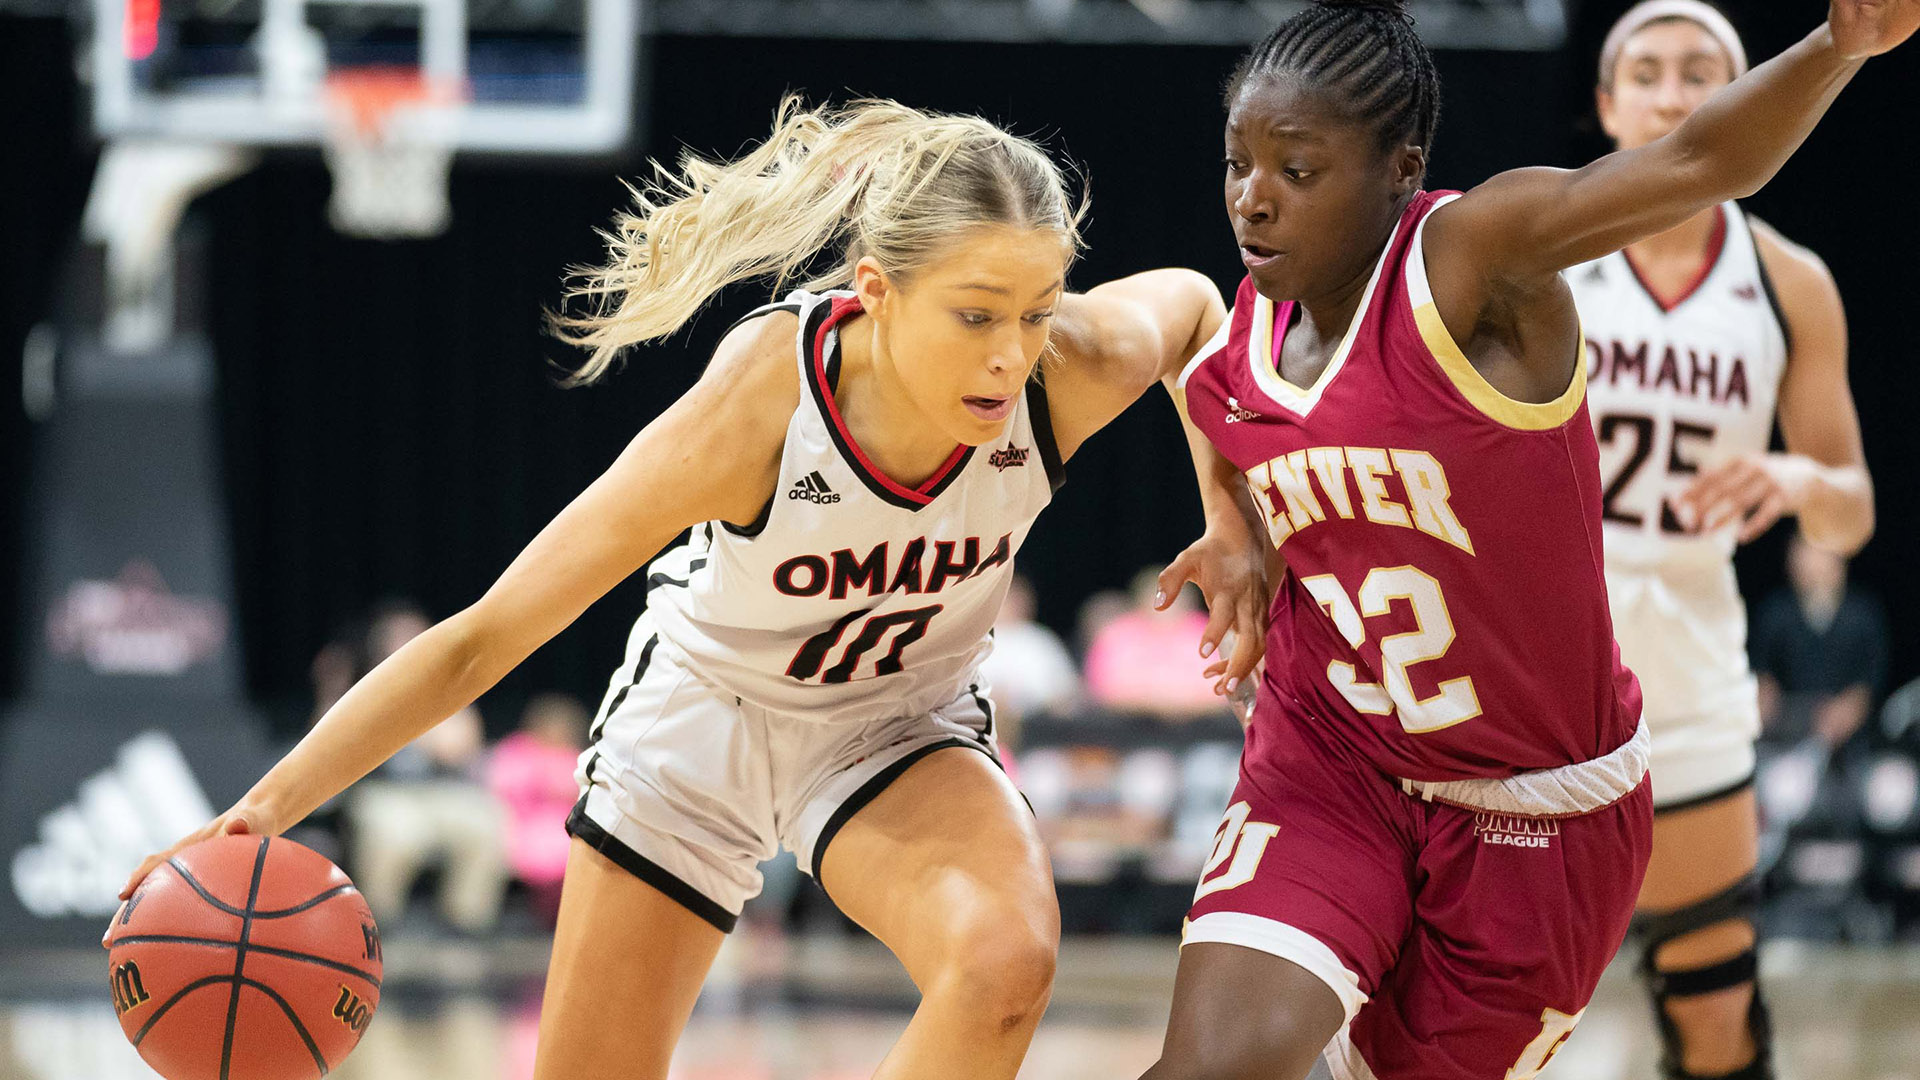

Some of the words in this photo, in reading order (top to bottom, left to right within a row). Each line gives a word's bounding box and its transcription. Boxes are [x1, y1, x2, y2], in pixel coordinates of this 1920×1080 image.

[788, 487, 841, 504] adidas
[1246, 446, 1476, 557] ENVER
[773, 531, 1013, 600] OMAHA
[784, 604, 944, 684] 10
[1301, 564, 1483, 734] 32
[1483, 832, 1550, 848] LEAGUE
